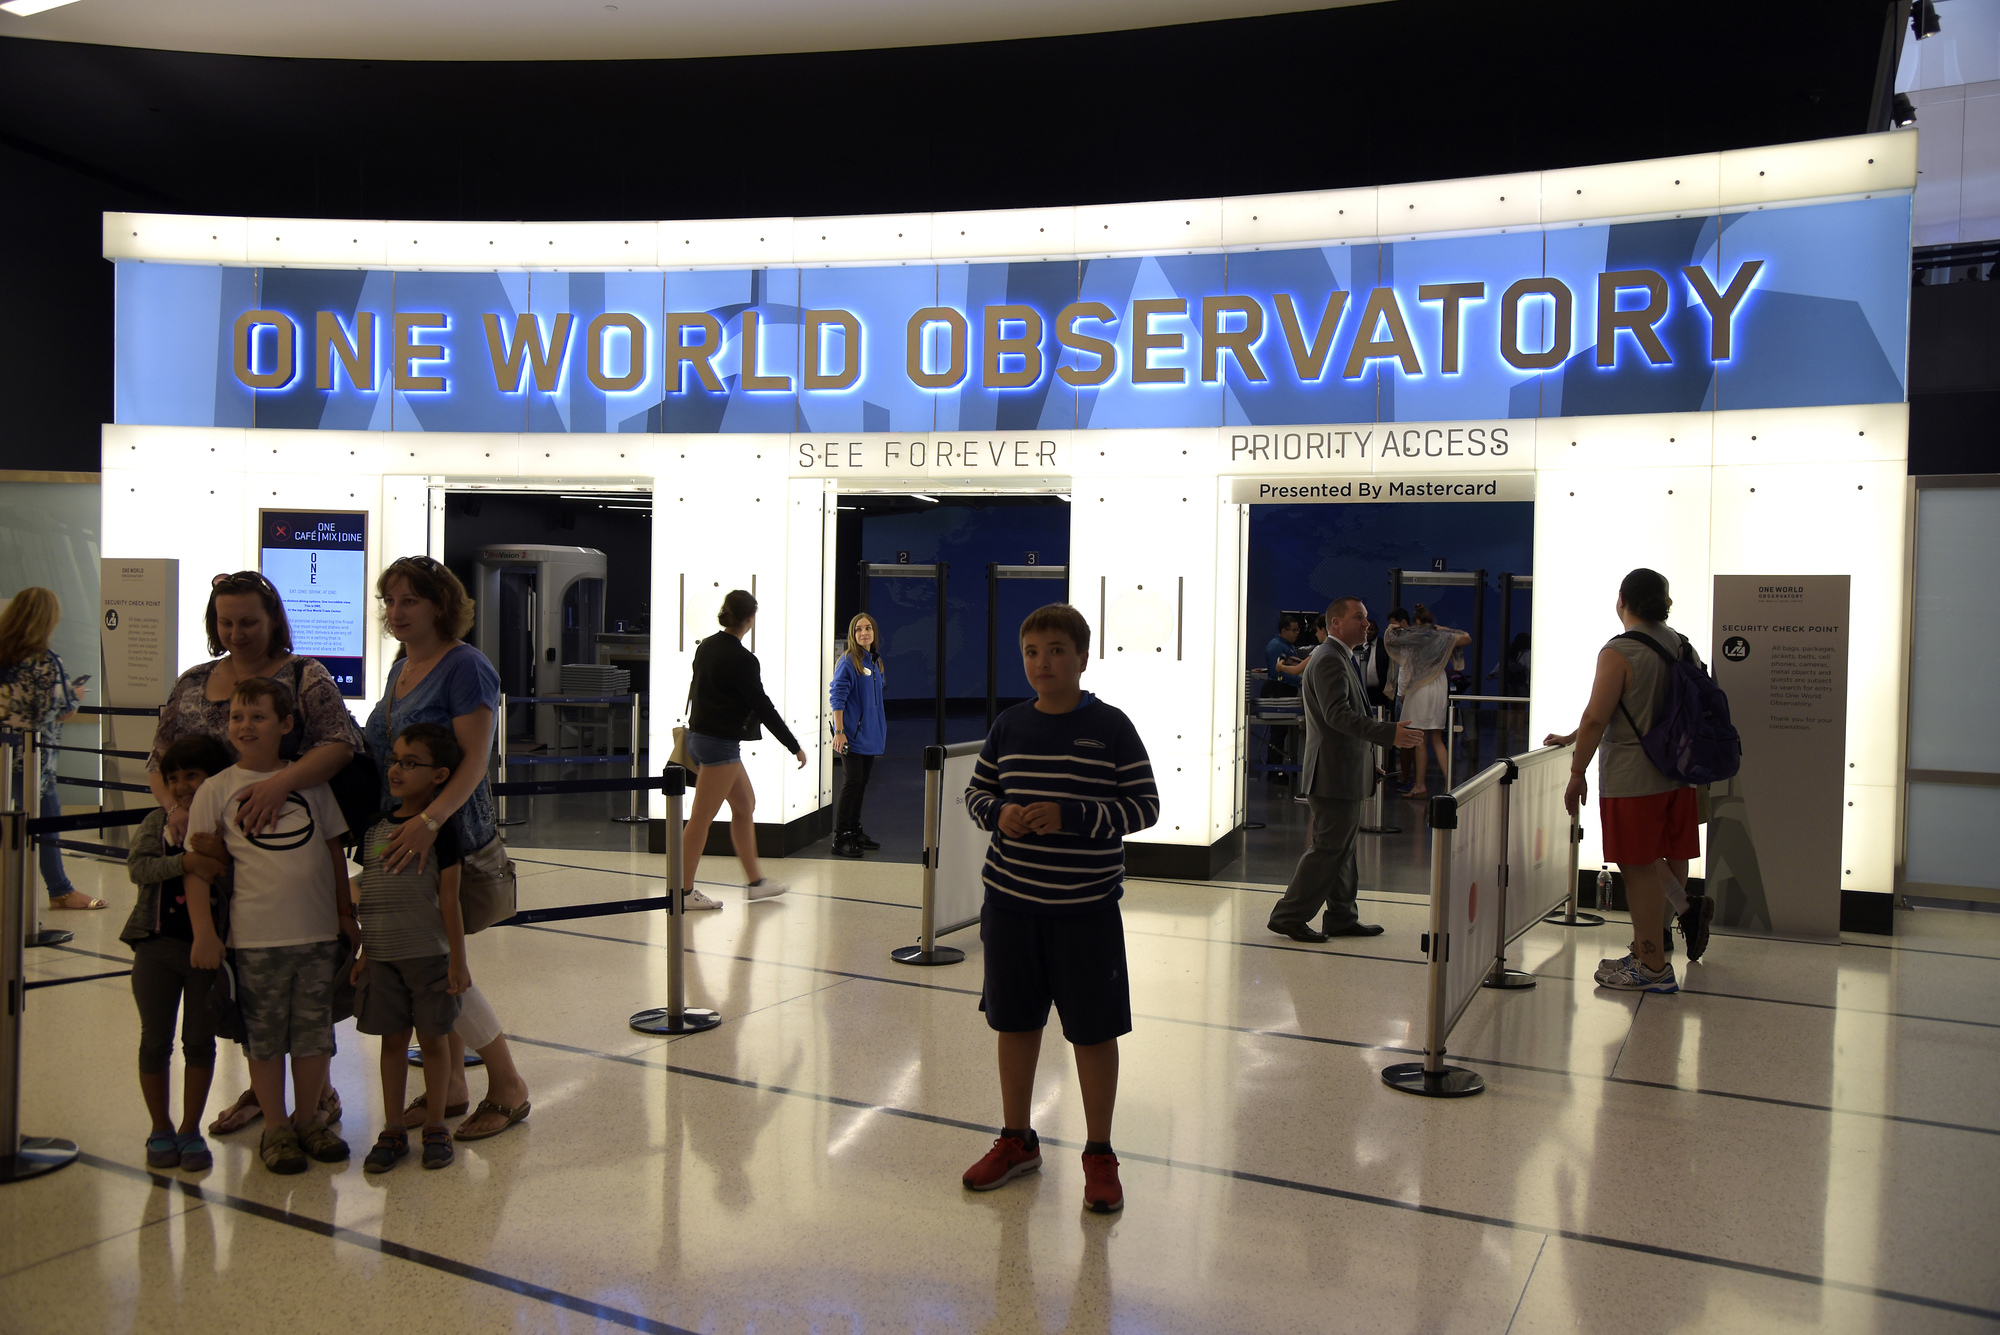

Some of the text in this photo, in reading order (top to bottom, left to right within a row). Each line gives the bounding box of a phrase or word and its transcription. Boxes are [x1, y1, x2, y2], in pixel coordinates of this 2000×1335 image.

[234, 259, 1764, 392] ONE WORLD OBSERVATORY
[1232, 428, 1509, 461] PRIORITY ACCESS
[799, 441, 1056, 467] SEE FOREVER
[1259, 480, 1496, 499] Presented By Mastercard
[318, 522, 335, 532] ONE
[900, 552, 907, 563] 2
[1028, 553, 1035, 564] 3
[1435, 559, 1442, 571] 4
[618, 621, 624, 632] 1
[1722, 624, 1769, 632] SECURITY
[1769, 700, 1813, 708] Observatory.
